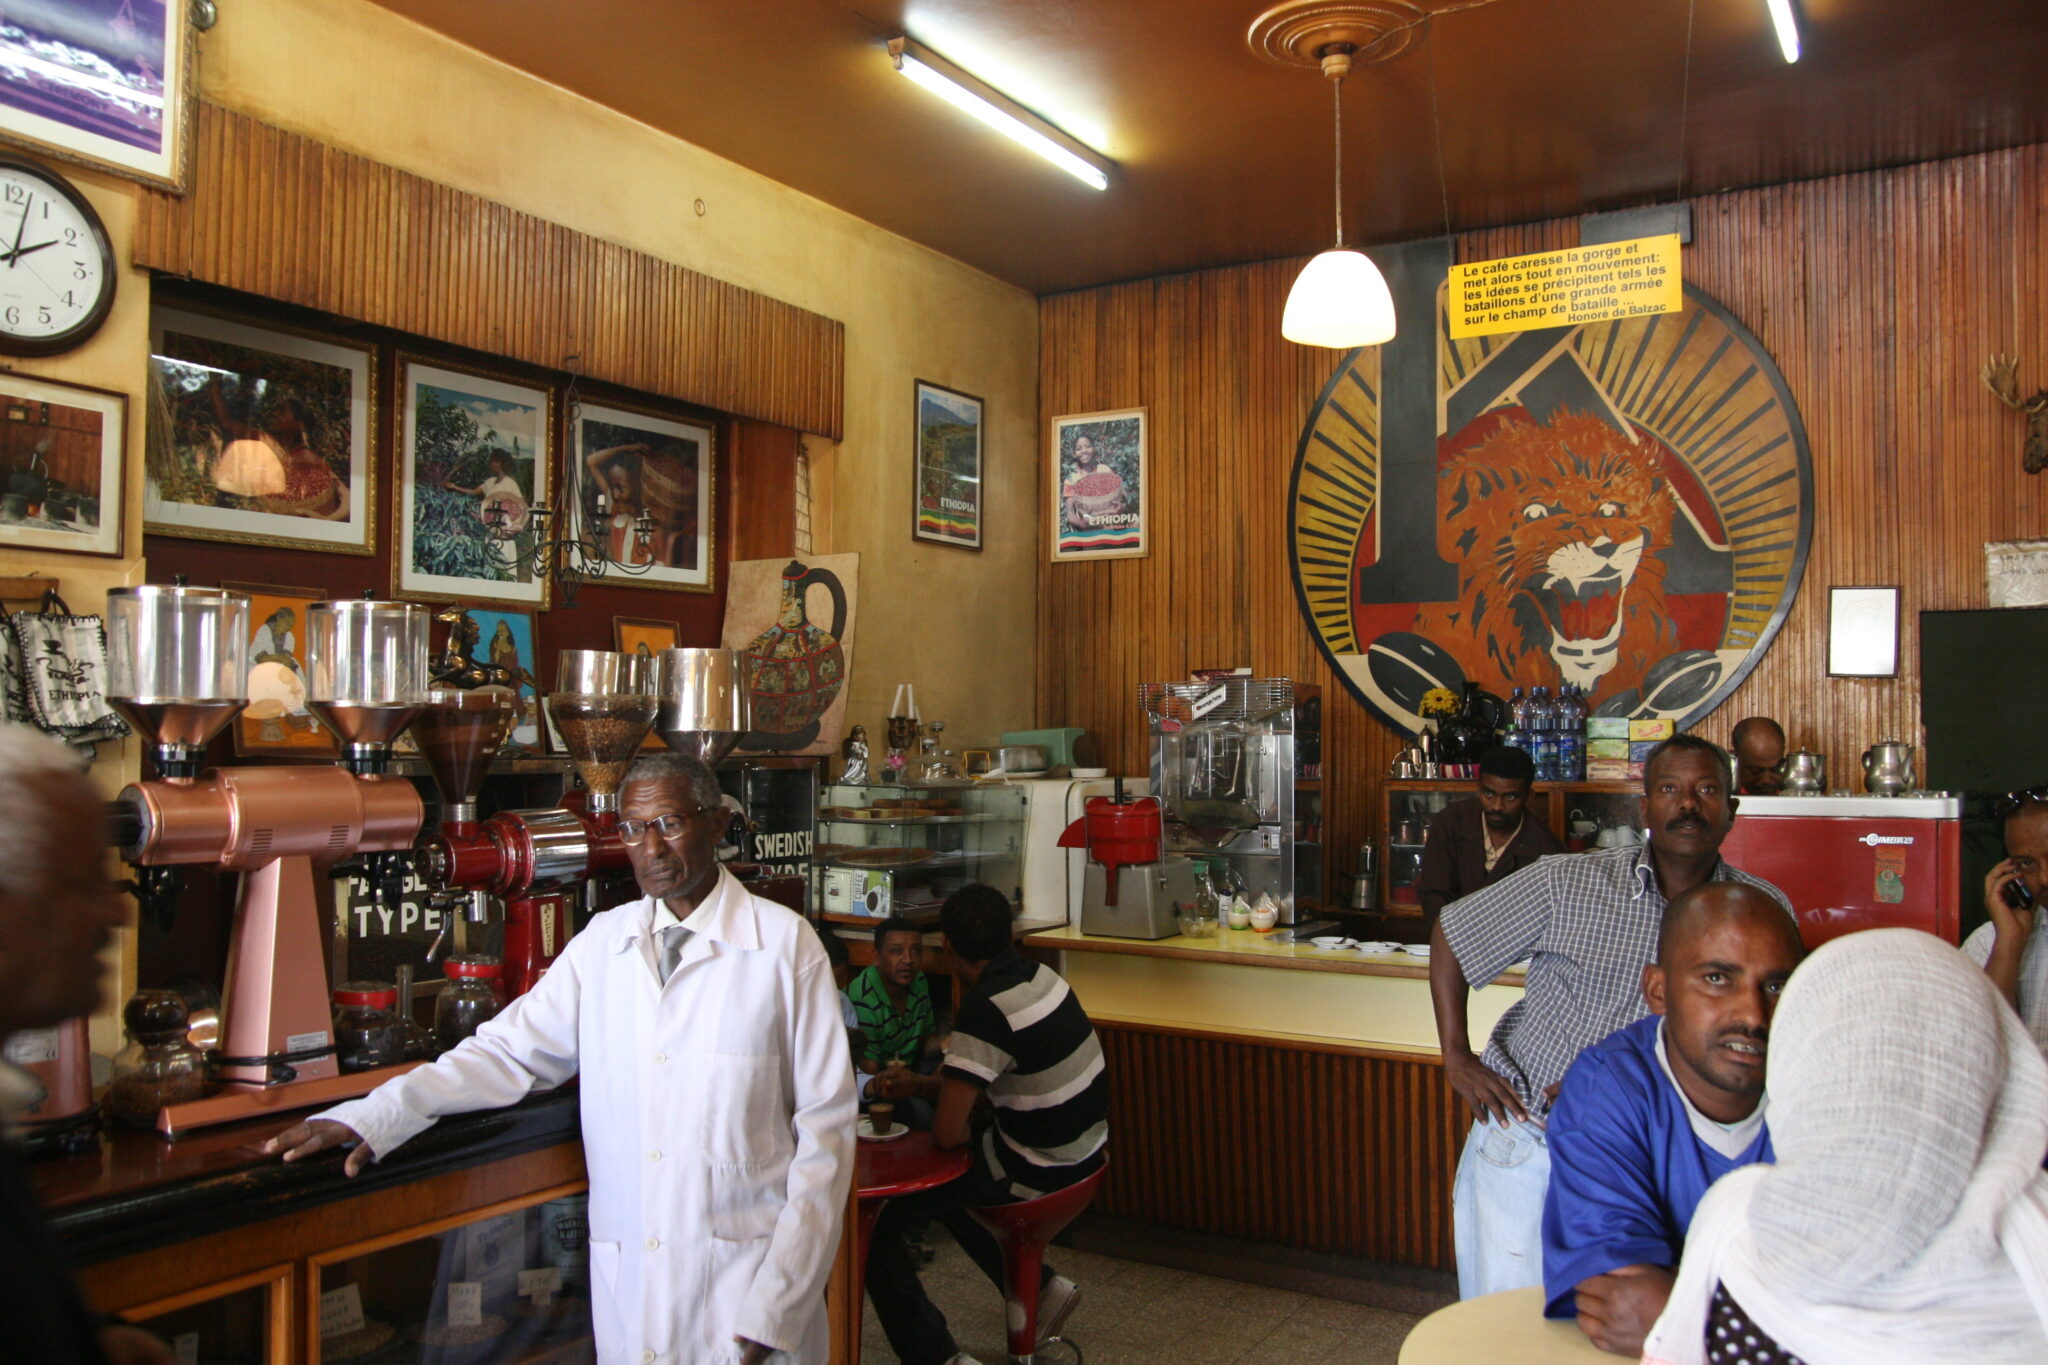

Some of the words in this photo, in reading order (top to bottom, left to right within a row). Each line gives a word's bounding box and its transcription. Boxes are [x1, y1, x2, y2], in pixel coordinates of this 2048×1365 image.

[5, 183, 25, 206] 12
[64, 227, 77, 247] 2
[73, 261, 87, 280] 3
[1463, 267, 1479, 277] Le
[1482, 260, 1509, 274] café
[1513, 256, 1563, 270] caresse
[1567, 252, 1578, 262] la
[1583, 247, 1621, 262] gorge
[1625, 243, 1638, 254] et
[1464, 277, 1487, 288] met
[1491, 273, 1522, 284] alors
[1526, 268, 1552, 280] tout
[1556, 266, 1572, 276] en
[1576, 253, 1660, 273] mouvement:
[1464, 290, 1482, 300] les
[1486, 285, 1520, 298] idées
[1524, 283, 1538, 292] se
[1543, 271, 1614, 292] précipitent
[1618, 268, 1642, 280] tels
[1646, 265, 1666, 276] les
[60, 290, 77, 307] 4
[1464, 297, 1526, 312] bataillons
[1529, 293, 1566, 304] d'une
[1570, 284, 1616, 301] grande
[1621, 278, 1663, 292] armée
[5, 306, 20, 326] 6
[38, 306, 52, 324] 5
[1464, 315, 1485, 326] sur
[1488, 312, 1500, 322] le
[1503, 307, 1547, 319] champ
[1551, 303, 1566, 314] de
[1571, 297, 1618, 312] bataille
[1568, 309, 1609, 323] Honoré
[1612, 307, 1626, 317] de
[1629, 303, 1667, 315] Balzac
[940, 497, 976, 513] ETHIOPIA
[1088, 513, 1140, 526] ETHIOPIA
[755, 830, 813, 860] SWEDISH
[354, 902, 440, 938] TYPE
